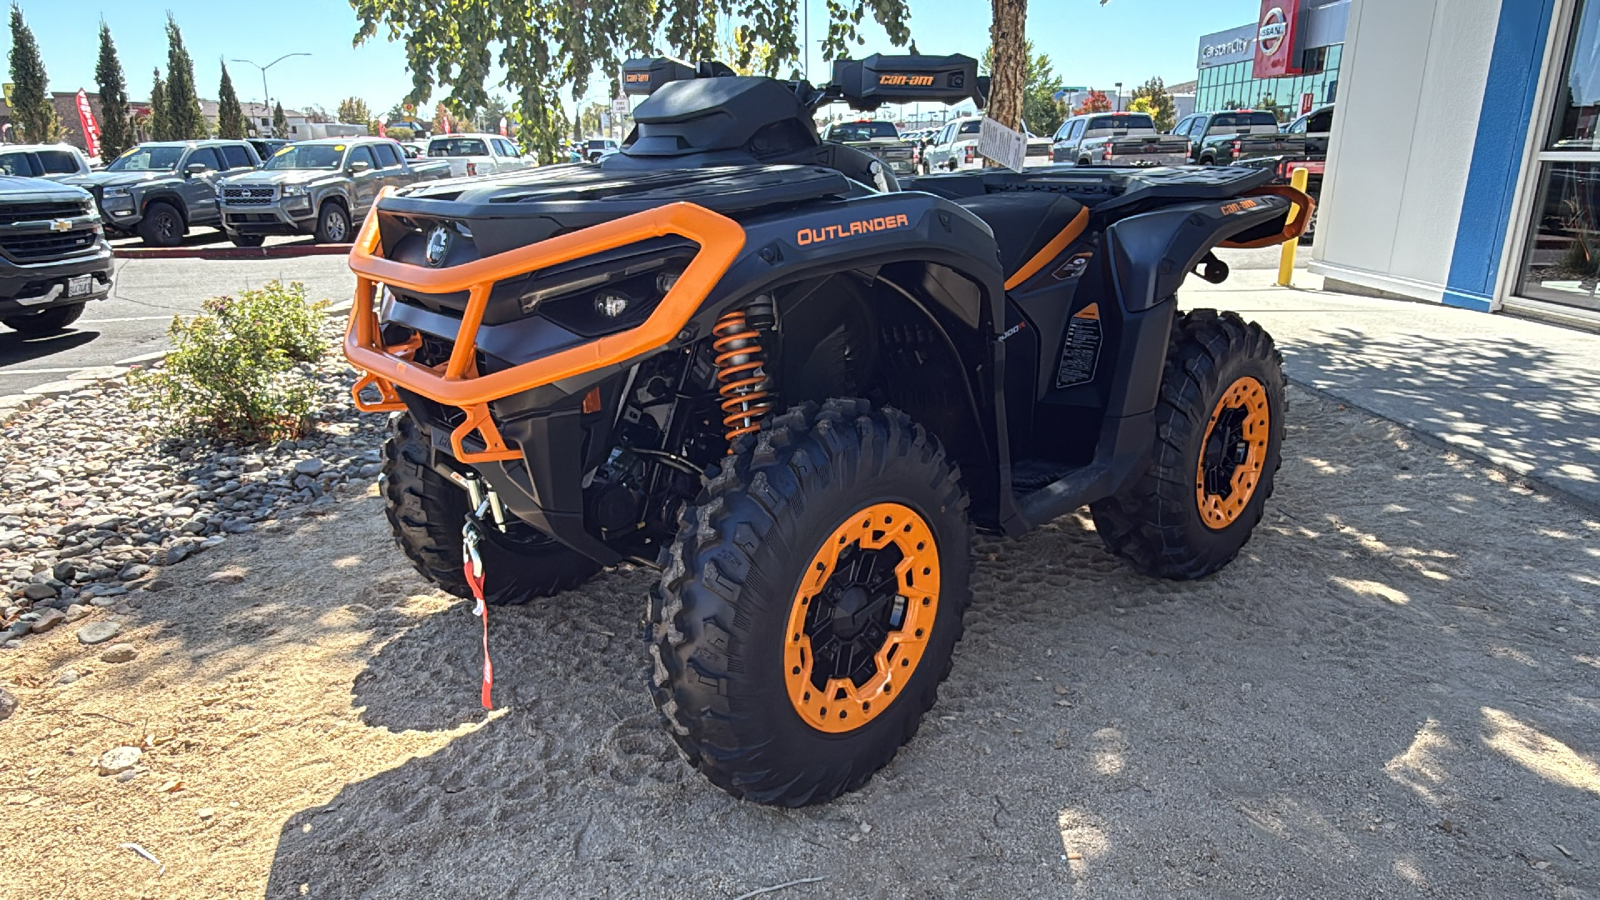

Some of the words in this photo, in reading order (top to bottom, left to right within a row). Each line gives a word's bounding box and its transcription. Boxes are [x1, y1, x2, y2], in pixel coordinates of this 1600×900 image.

[626, 74, 649, 83] can-am
[879, 75, 934, 86] can-am
[1220, 199, 1257, 216] can-am
[797, 214, 908, 245] OUTLANDER
[432, 245, 445, 253] BRP
